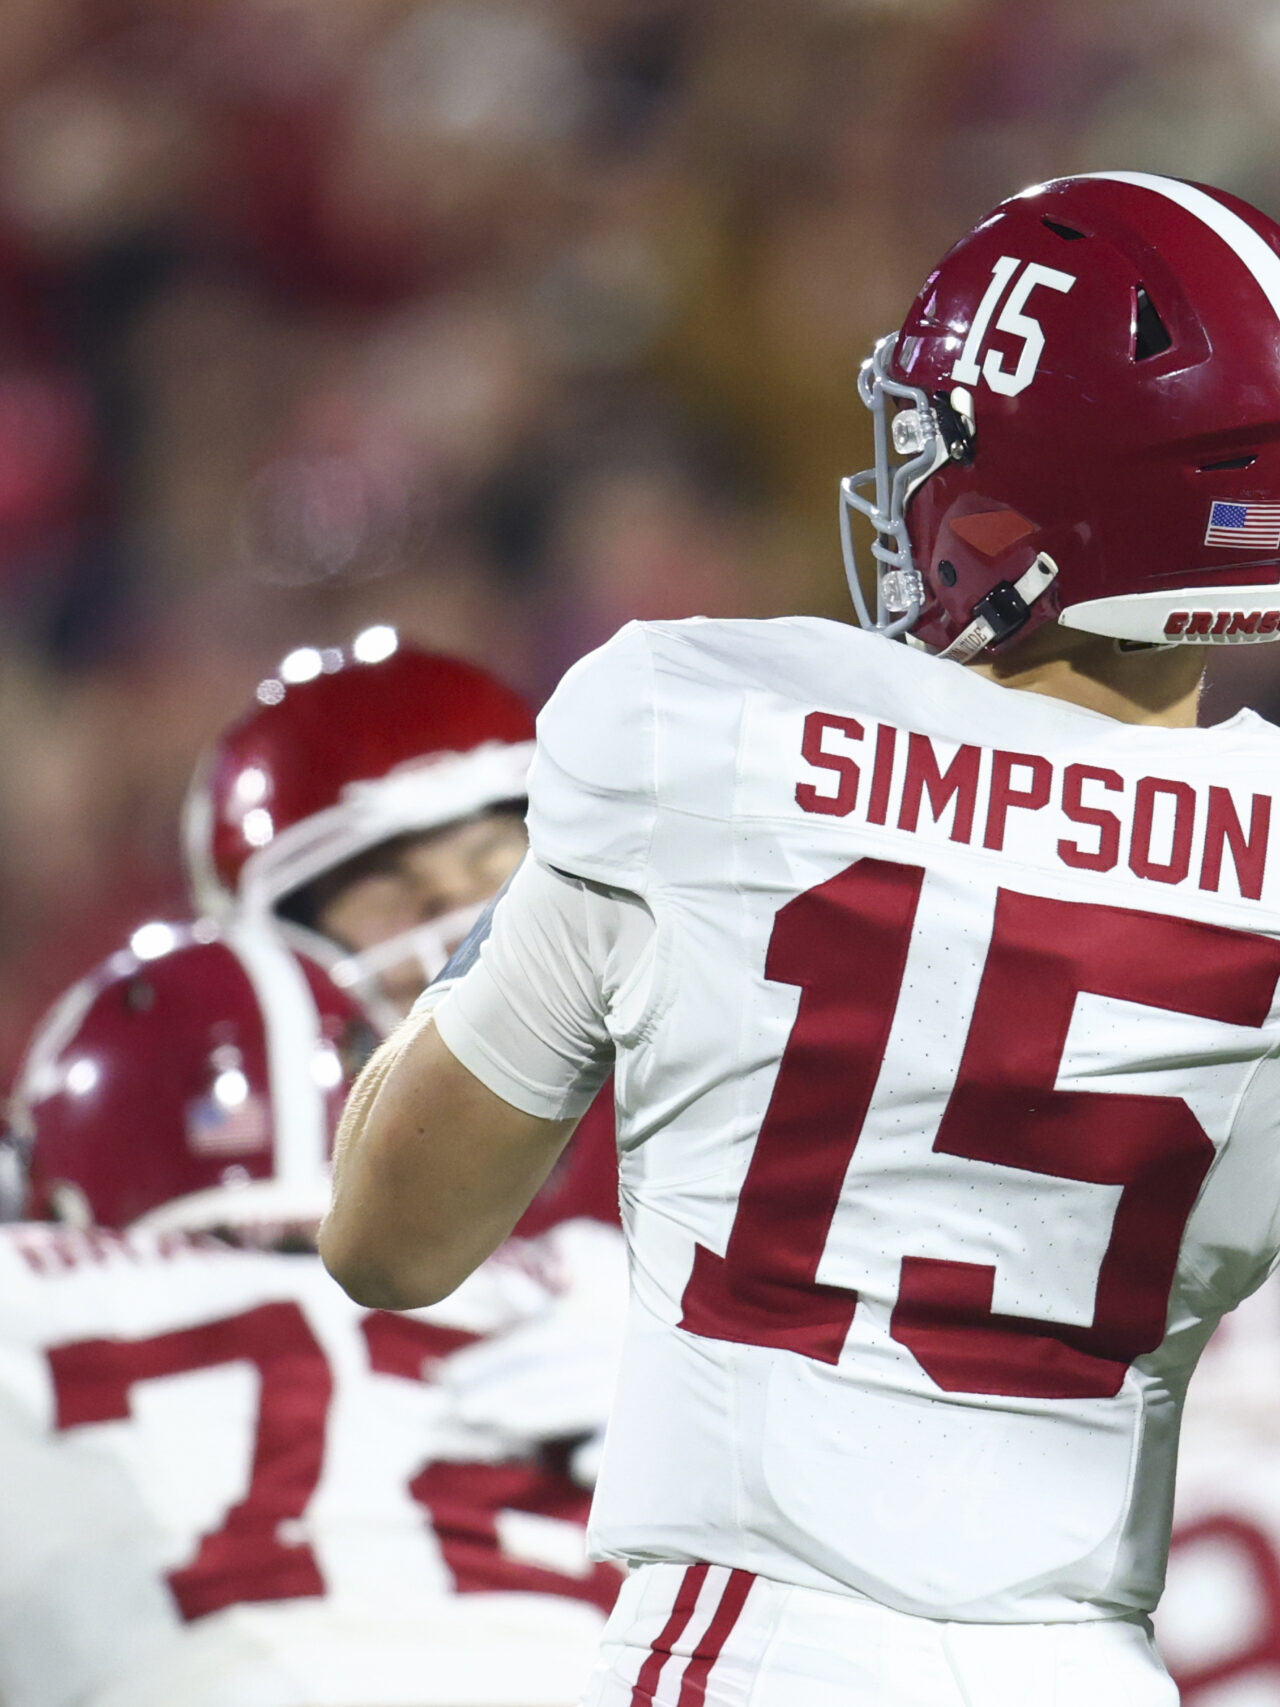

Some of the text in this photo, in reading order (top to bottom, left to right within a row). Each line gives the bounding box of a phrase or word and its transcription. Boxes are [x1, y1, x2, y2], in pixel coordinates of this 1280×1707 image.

[950, 255, 1077, 398] 15
[960, 626, 988, 652] TIDE
[794, 710, 1273, 901] SIMPSON
